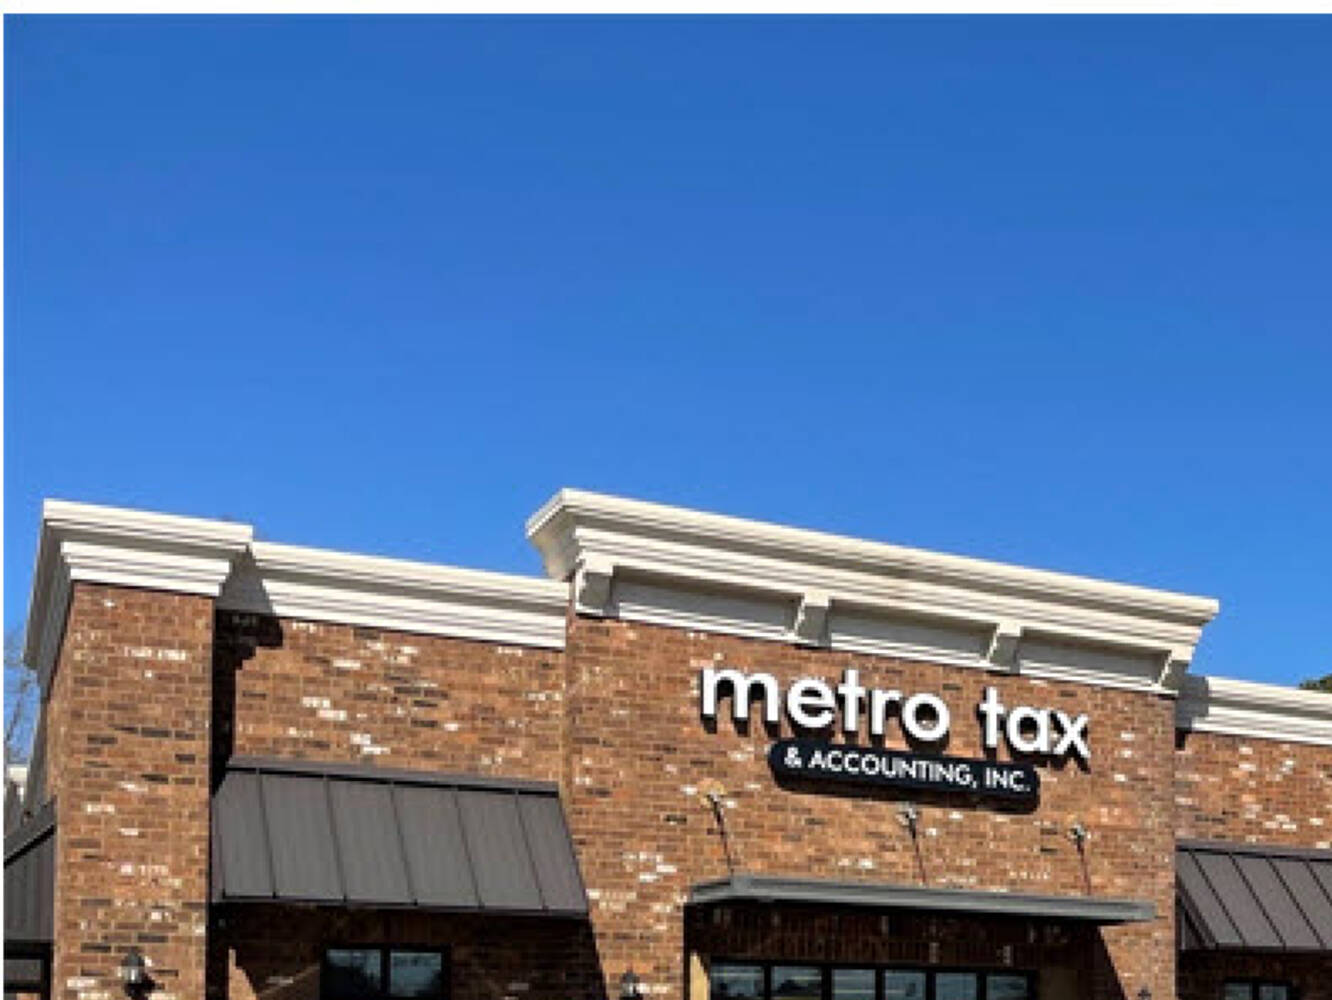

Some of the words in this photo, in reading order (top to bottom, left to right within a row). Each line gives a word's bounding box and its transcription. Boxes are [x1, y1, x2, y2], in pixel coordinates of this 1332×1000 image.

[701, 666, 951, 742] metro
[978, 686, 1091, 758] tax
[783, 746, 803, 769] &
[808, 749, 977, 788] ACCOUNTING,
[984, 766, 1032, 793] INC.
